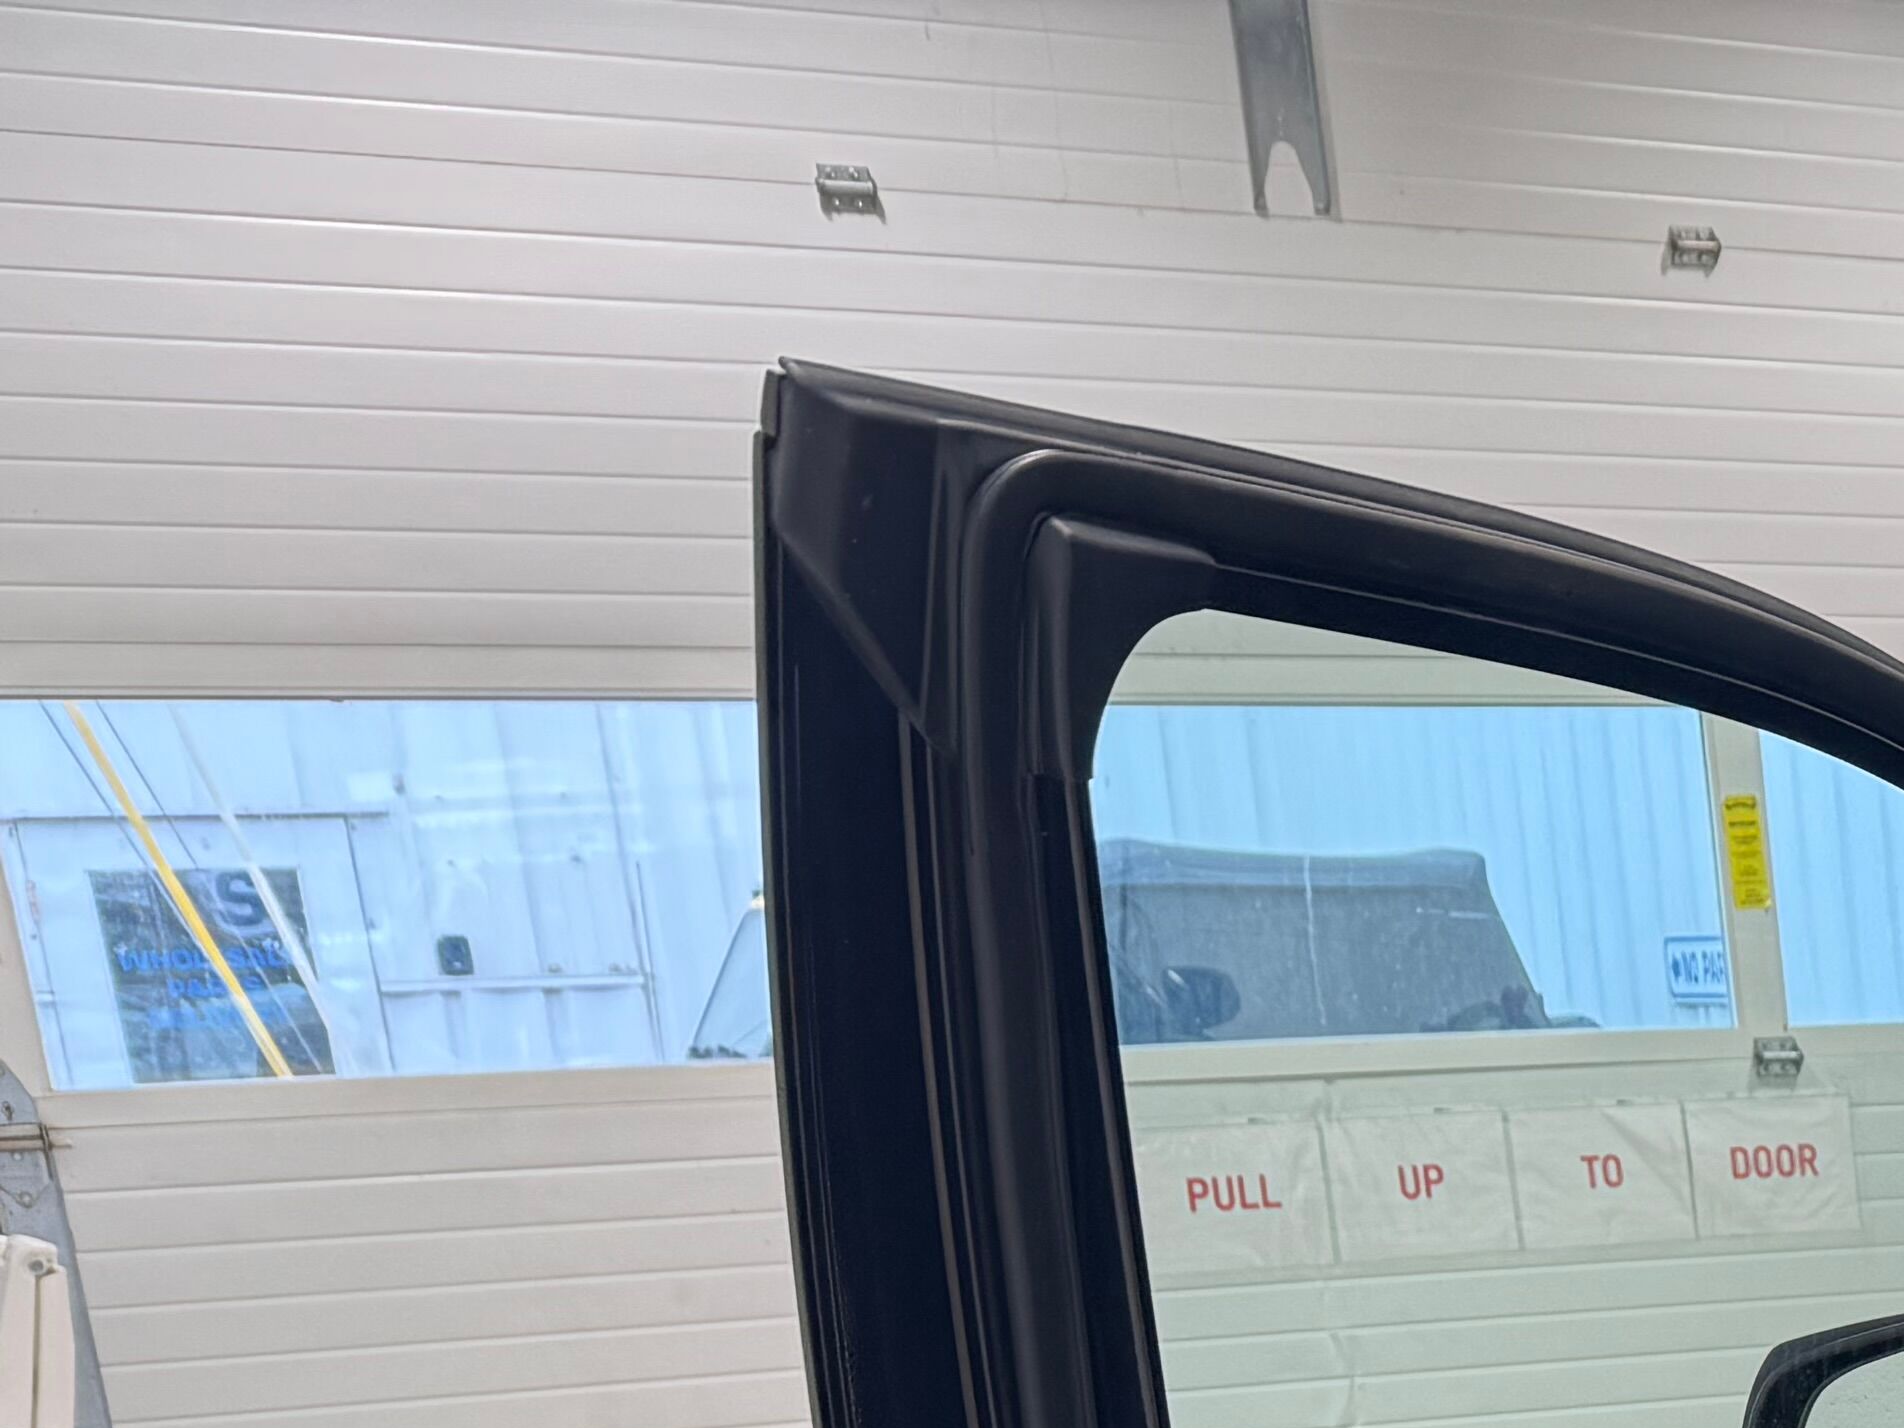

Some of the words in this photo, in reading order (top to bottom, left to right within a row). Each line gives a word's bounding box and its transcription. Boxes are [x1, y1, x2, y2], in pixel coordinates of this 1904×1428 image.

[1185, 1172, 1283, 1214] PULL
[1397, 1163, 1446, 1201] UP
[1579, 1152, 1625, 1190] TO
[1728, 1142, 1820, 1181] DOOR
